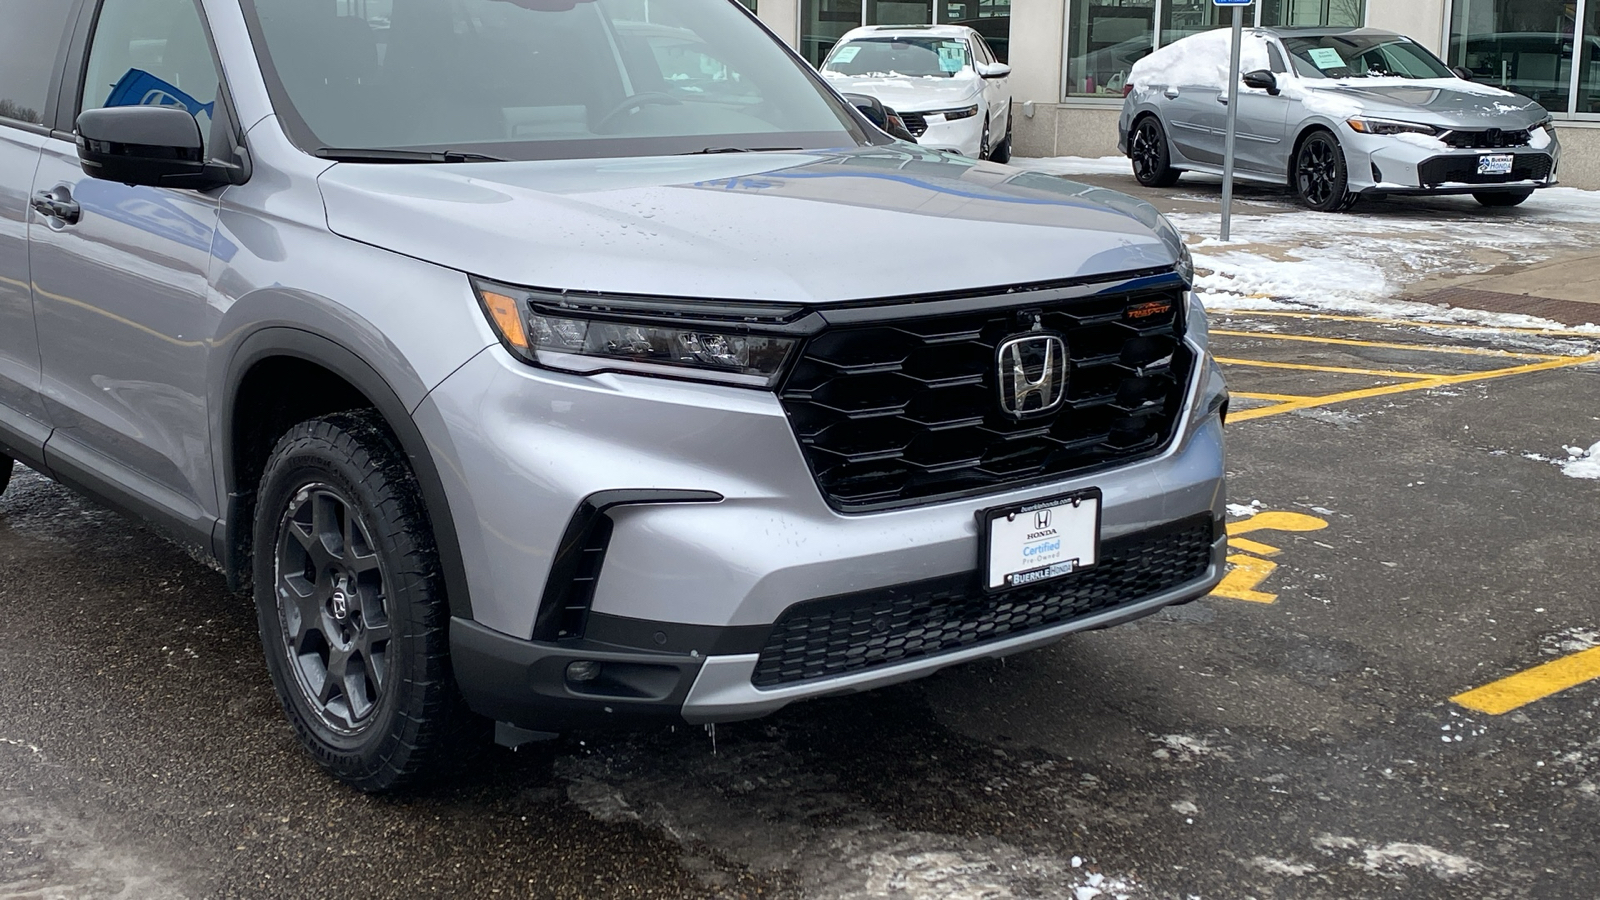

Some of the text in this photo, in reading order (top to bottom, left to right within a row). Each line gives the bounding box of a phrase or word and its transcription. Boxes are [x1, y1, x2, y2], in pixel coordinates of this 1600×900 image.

[1021, 498, 1072, 512] buerklehonda.com
[1027, 529, 1057, 539] HONDA
[1023, 540, 1060, 556] Certified
[1013, 564, 1071, 583] BUERKLE HONDA
